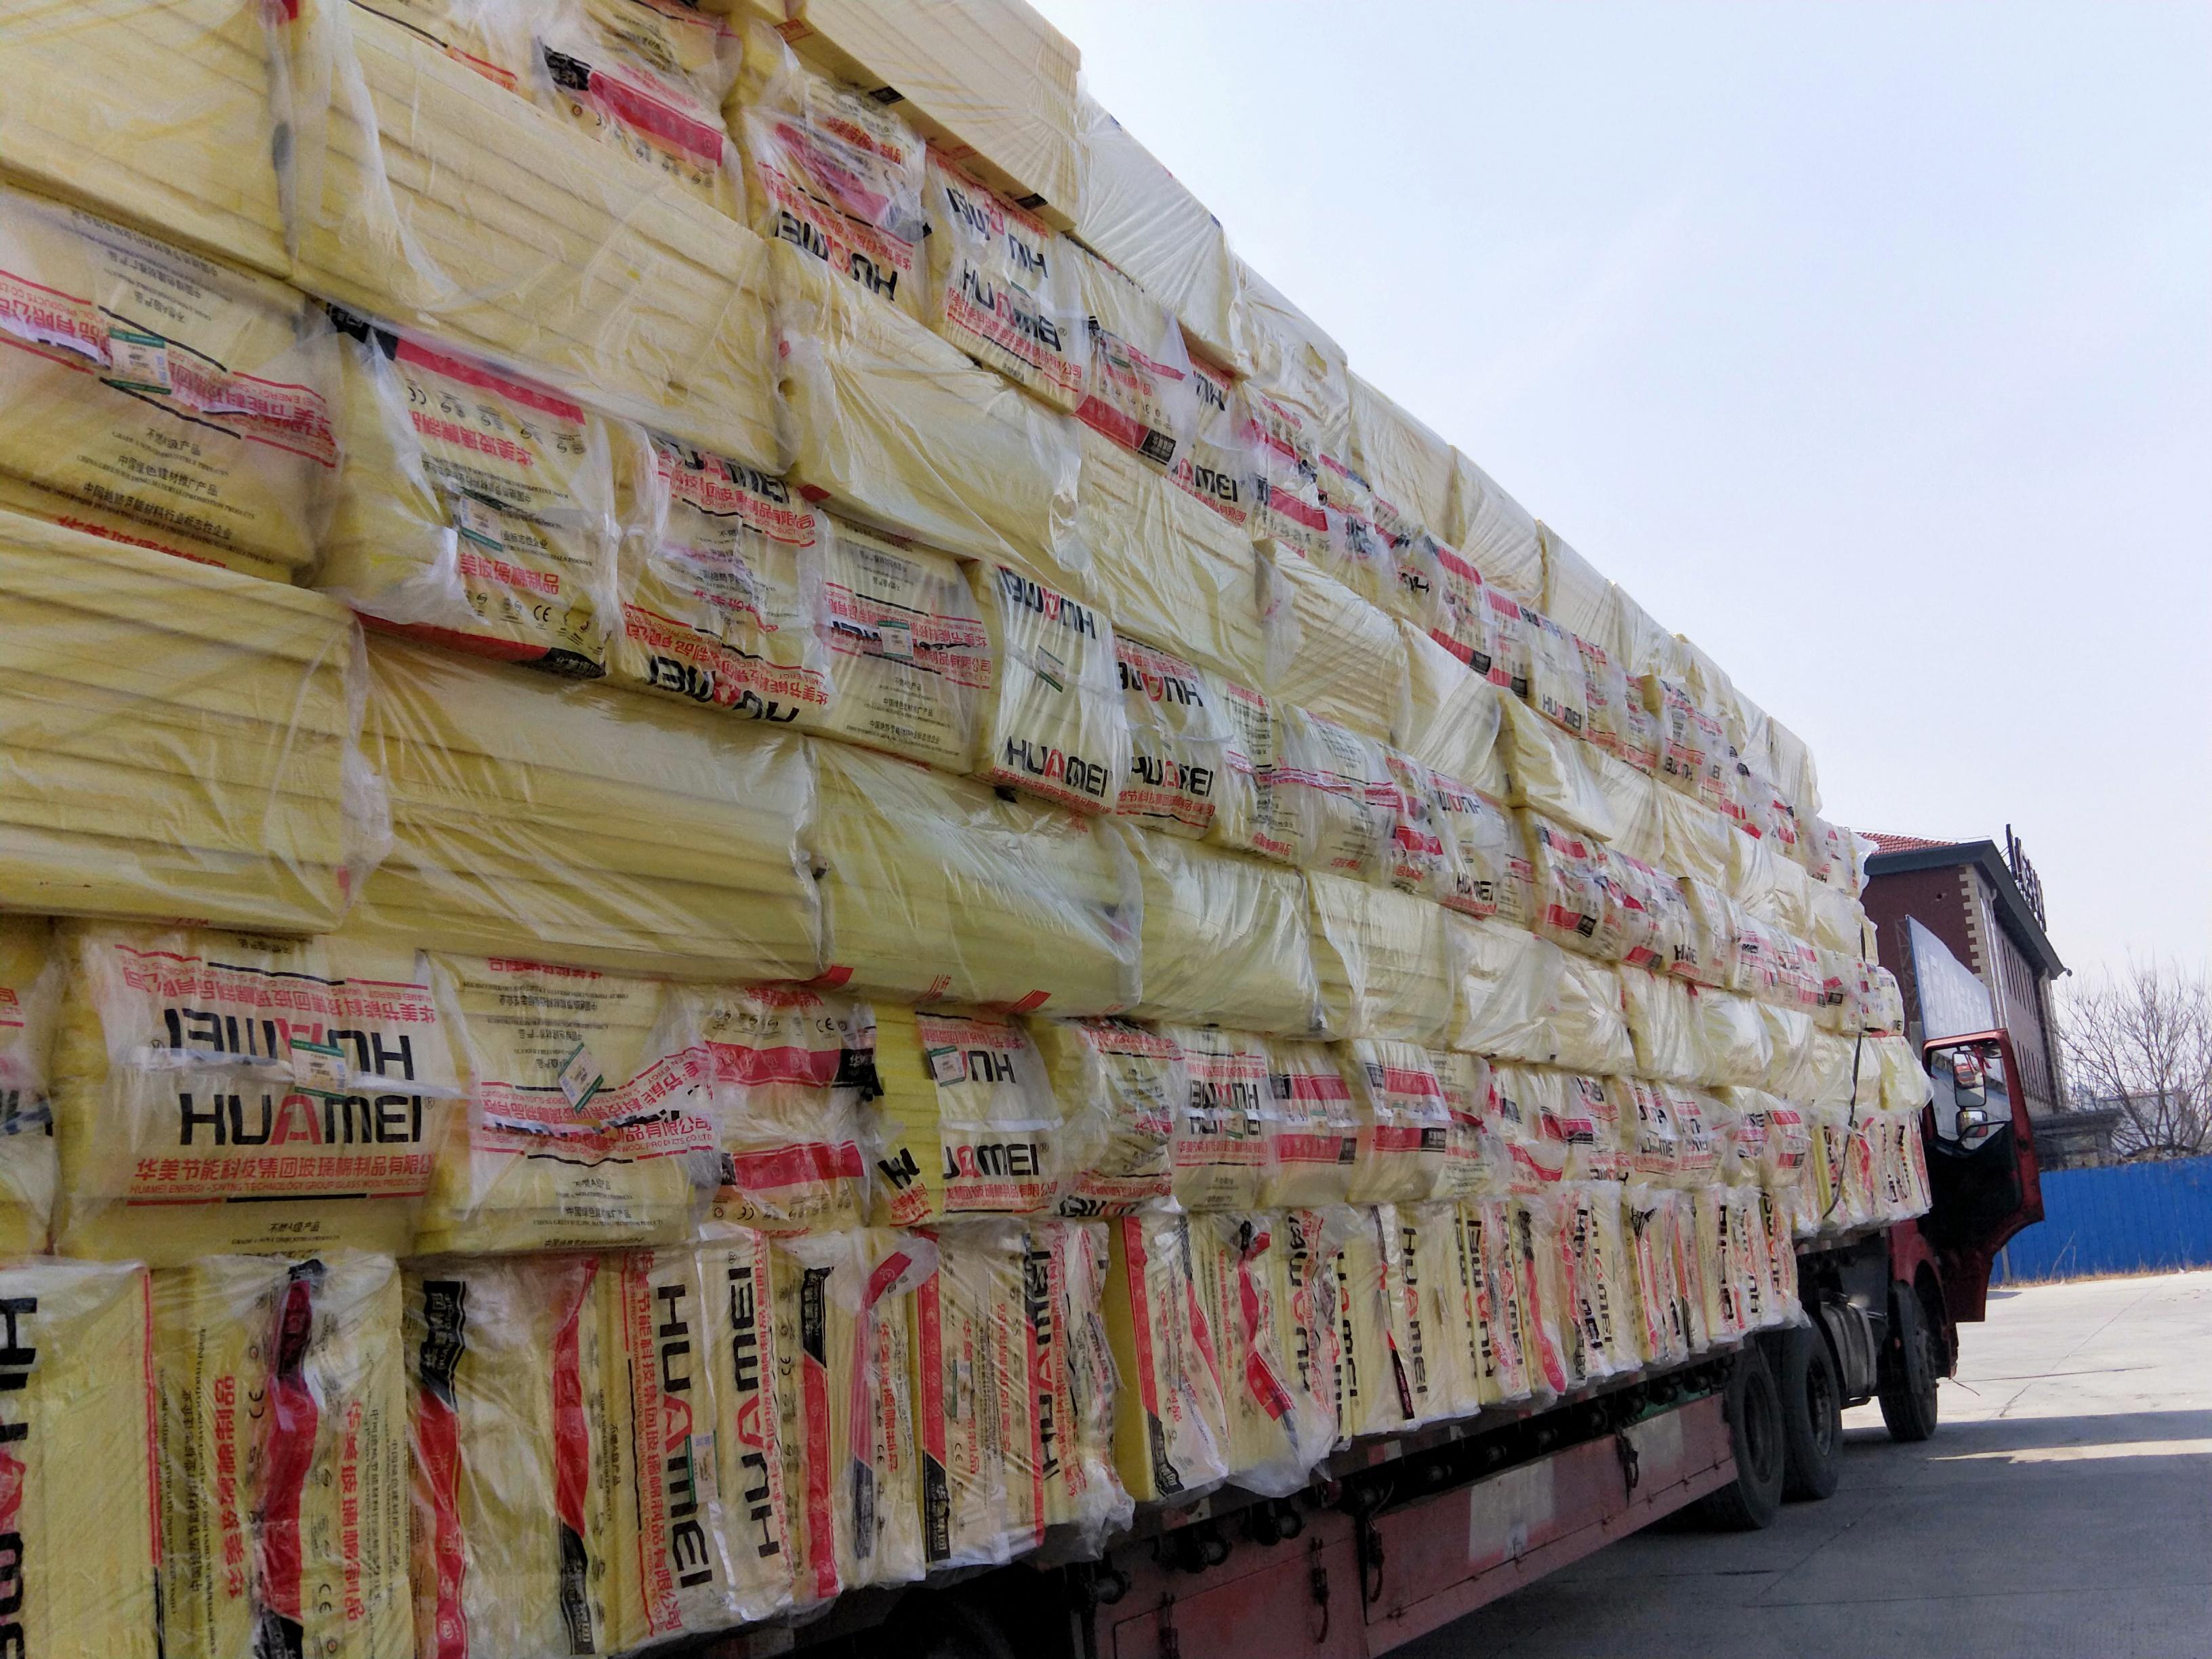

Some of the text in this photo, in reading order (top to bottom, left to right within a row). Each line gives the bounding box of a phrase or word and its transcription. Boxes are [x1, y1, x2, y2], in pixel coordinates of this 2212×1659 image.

[460, 552, 560, 595] 美玻璃棉制品
[1000, 567, 1097, 639] HUAMEI
[533, 605, 552, 623] CE
[1118, 662, 1204, 708] HUAME
[1006, 735, 1109, 798] HUAMEI
[179, 1094, 422, 1146] HUAMEI
[1403, 1227, 1427, 1393] HUAMEI
[657, 1284, 714, 1589] HUAMEI
[728, 1266, 781, 1559] HUAMEI
[213, 1374, 245, 1599] 华美玻璃棉制品
[340, 1398, 365, 1622] 华美玻璃棉制品
